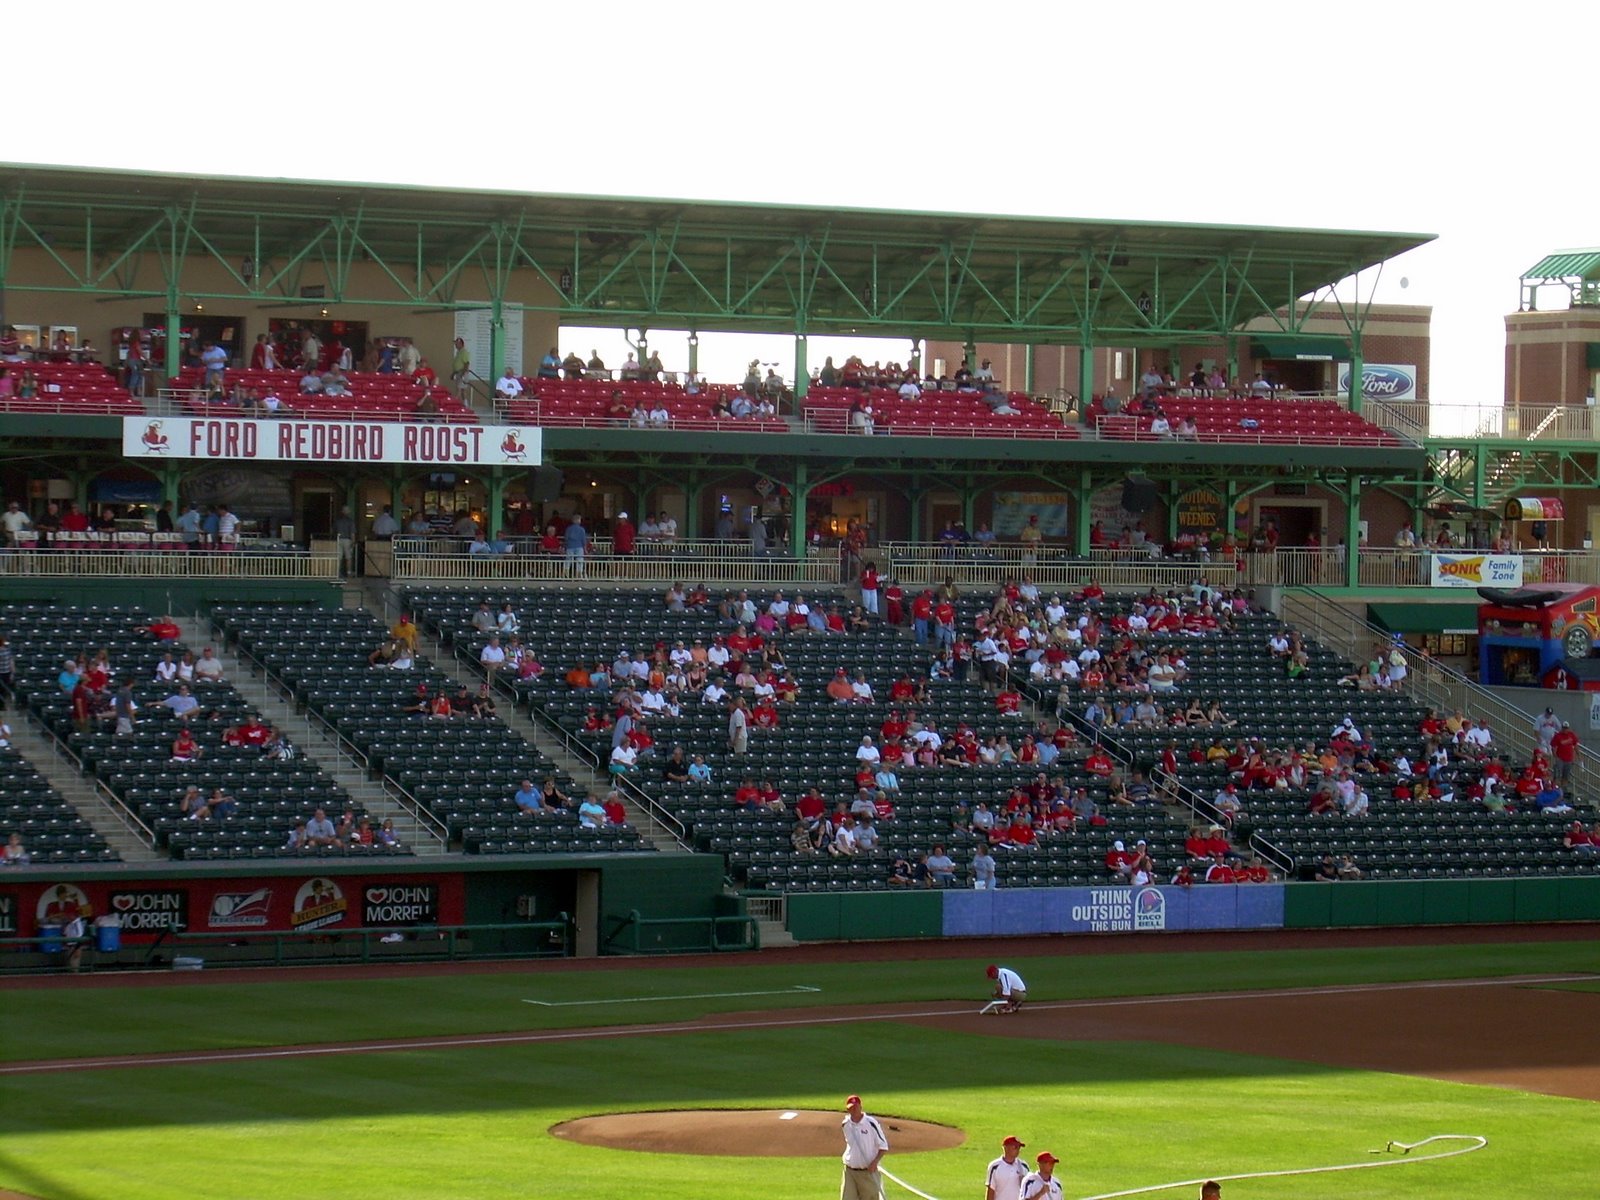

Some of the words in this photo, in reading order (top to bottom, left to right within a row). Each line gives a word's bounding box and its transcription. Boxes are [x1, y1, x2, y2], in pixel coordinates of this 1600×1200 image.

[1361, 370, 1399, 393] Ford
[189, 420, 256, 458] FORD
[278, 423, 383, 461] REDBIRD
[404, 426, 484, 463] ROOST
[1178, 511, 1217, 526] WEENIES
[1439, 563, 1481, 575] SONIC
[1488, 560, 1518, 572] Family
[1491, 571, 1515, 580] Zone
[133, 894, 180, 910] JOHN
[386, 887, 430, 903] JOHN
[1091, 890, 1132, 904] THINK
[1072, 905, 1132, 921] OUTSIDE
[1091, 921, 1110, 931] THE
[1112, 920, 1132, 931] BUN
